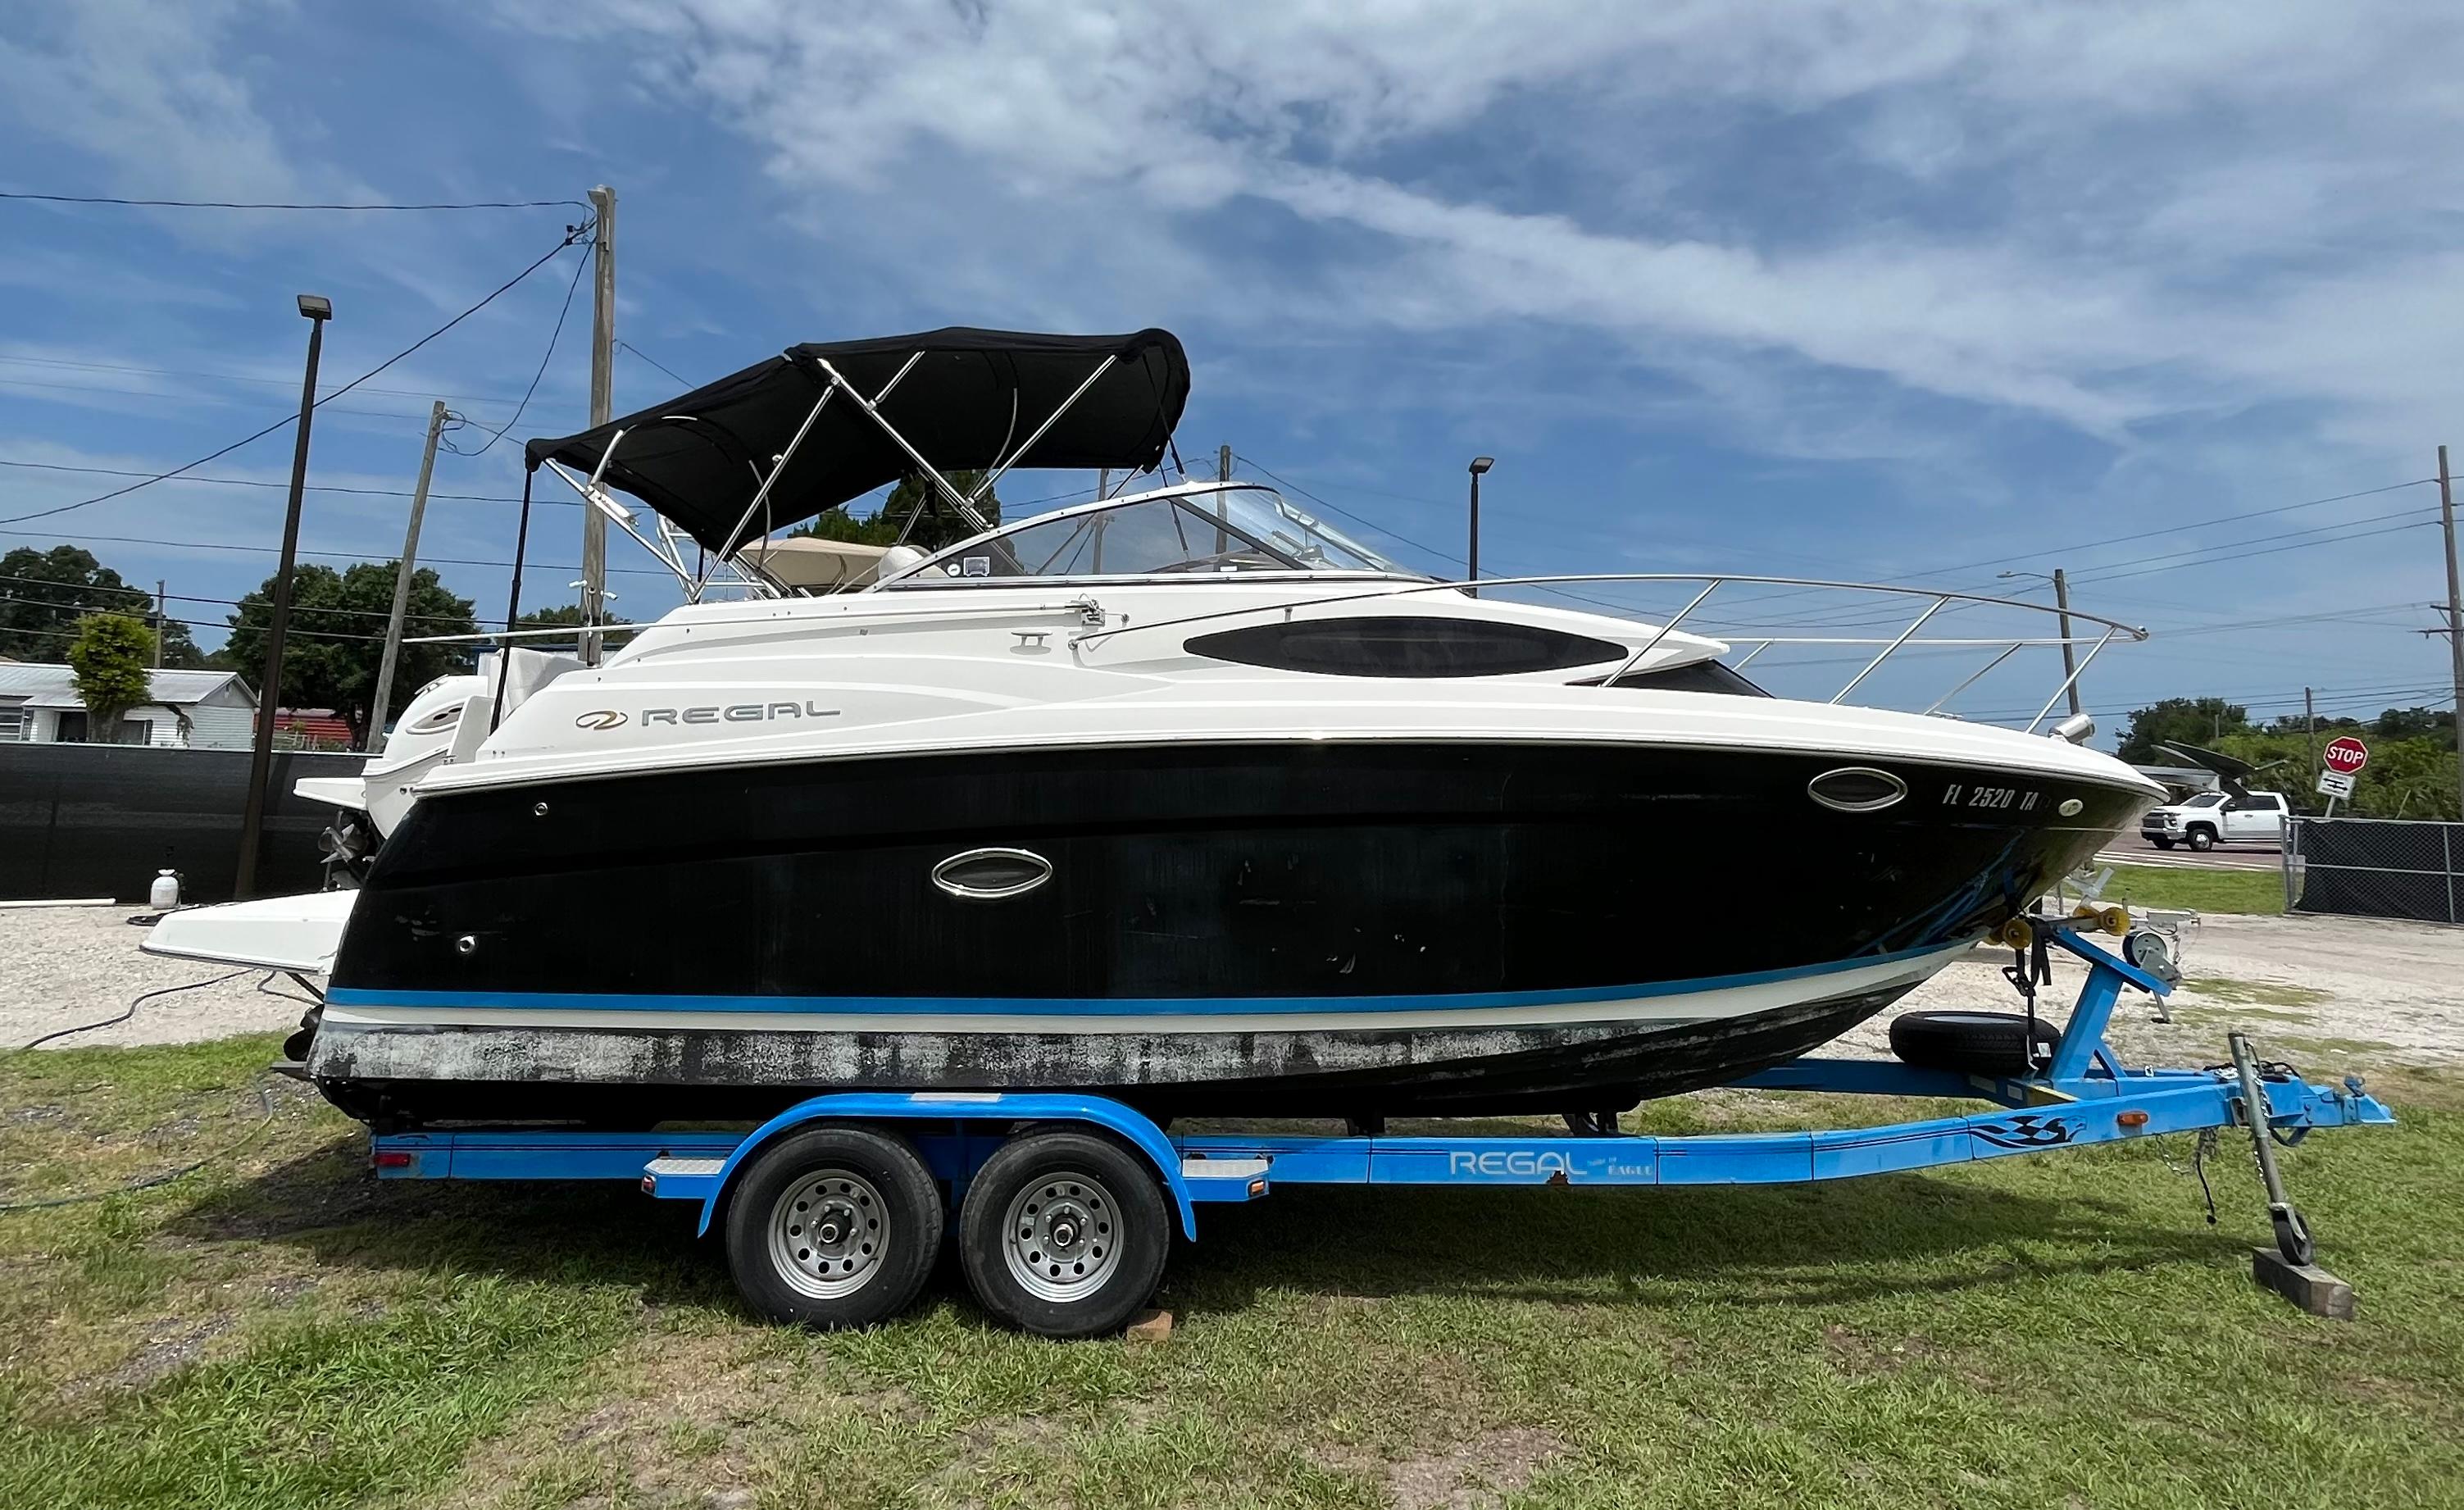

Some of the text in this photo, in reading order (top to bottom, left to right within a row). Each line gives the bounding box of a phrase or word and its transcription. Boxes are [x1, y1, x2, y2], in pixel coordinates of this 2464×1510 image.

[641, 700, 841, 727] REGAL
[2328, 746, 2363, 764] STOP
[1968, 787, 2016, 808] 2520
[2019, 792, 2039, 811] TA
[1450, 1151, 1587, 1174] REGAL
